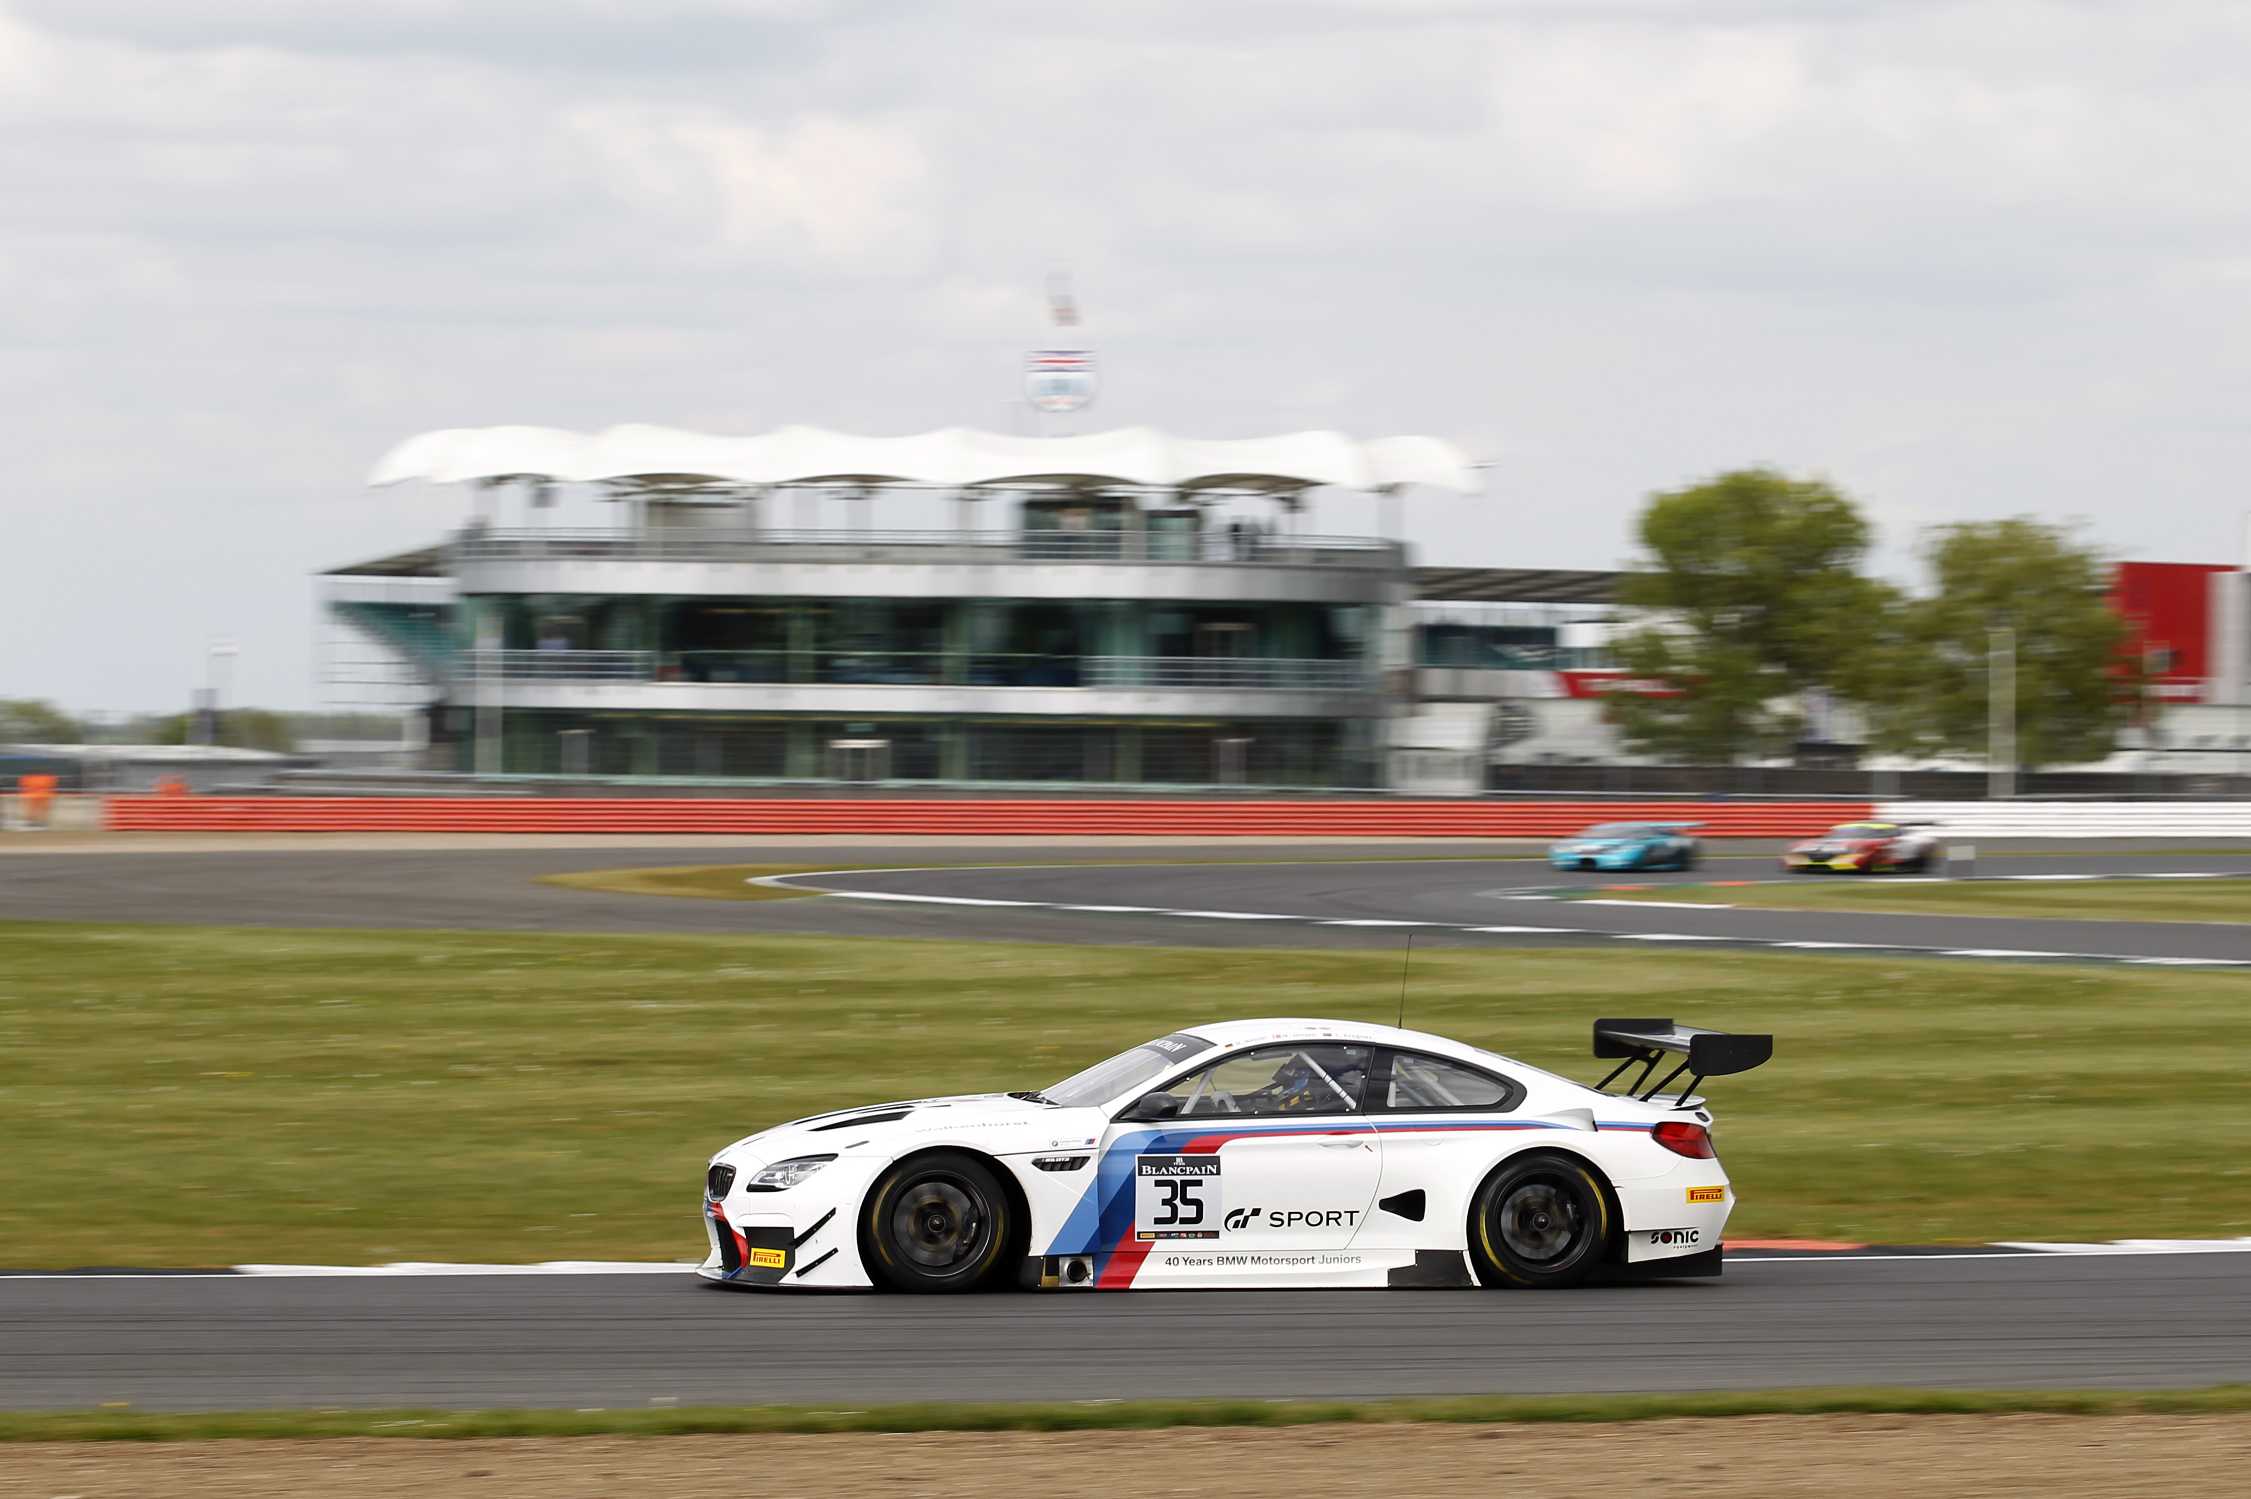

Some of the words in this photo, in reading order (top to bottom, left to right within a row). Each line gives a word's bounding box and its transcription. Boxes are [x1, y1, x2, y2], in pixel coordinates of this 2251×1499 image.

[1141, 1164, 1218, 1175] BLANCPAIN
[1689, 1188, 1722, 1201] PIRELLI
[1153, 1179, 1204, 1225] 35
[1268, 1210, 1360, 1228] SPORT
[753, 1251, 781, 1264] PIRELLI
[1164, 1256, 1180, 1267] 40
[1182, 1256, 1214, 1266] Years
[1216, 1255, 1248, 1266] BMW
[1250, 1255, 1315, 1266] Motorsport
[1318, 1254, 1361, 1265] Juniors
